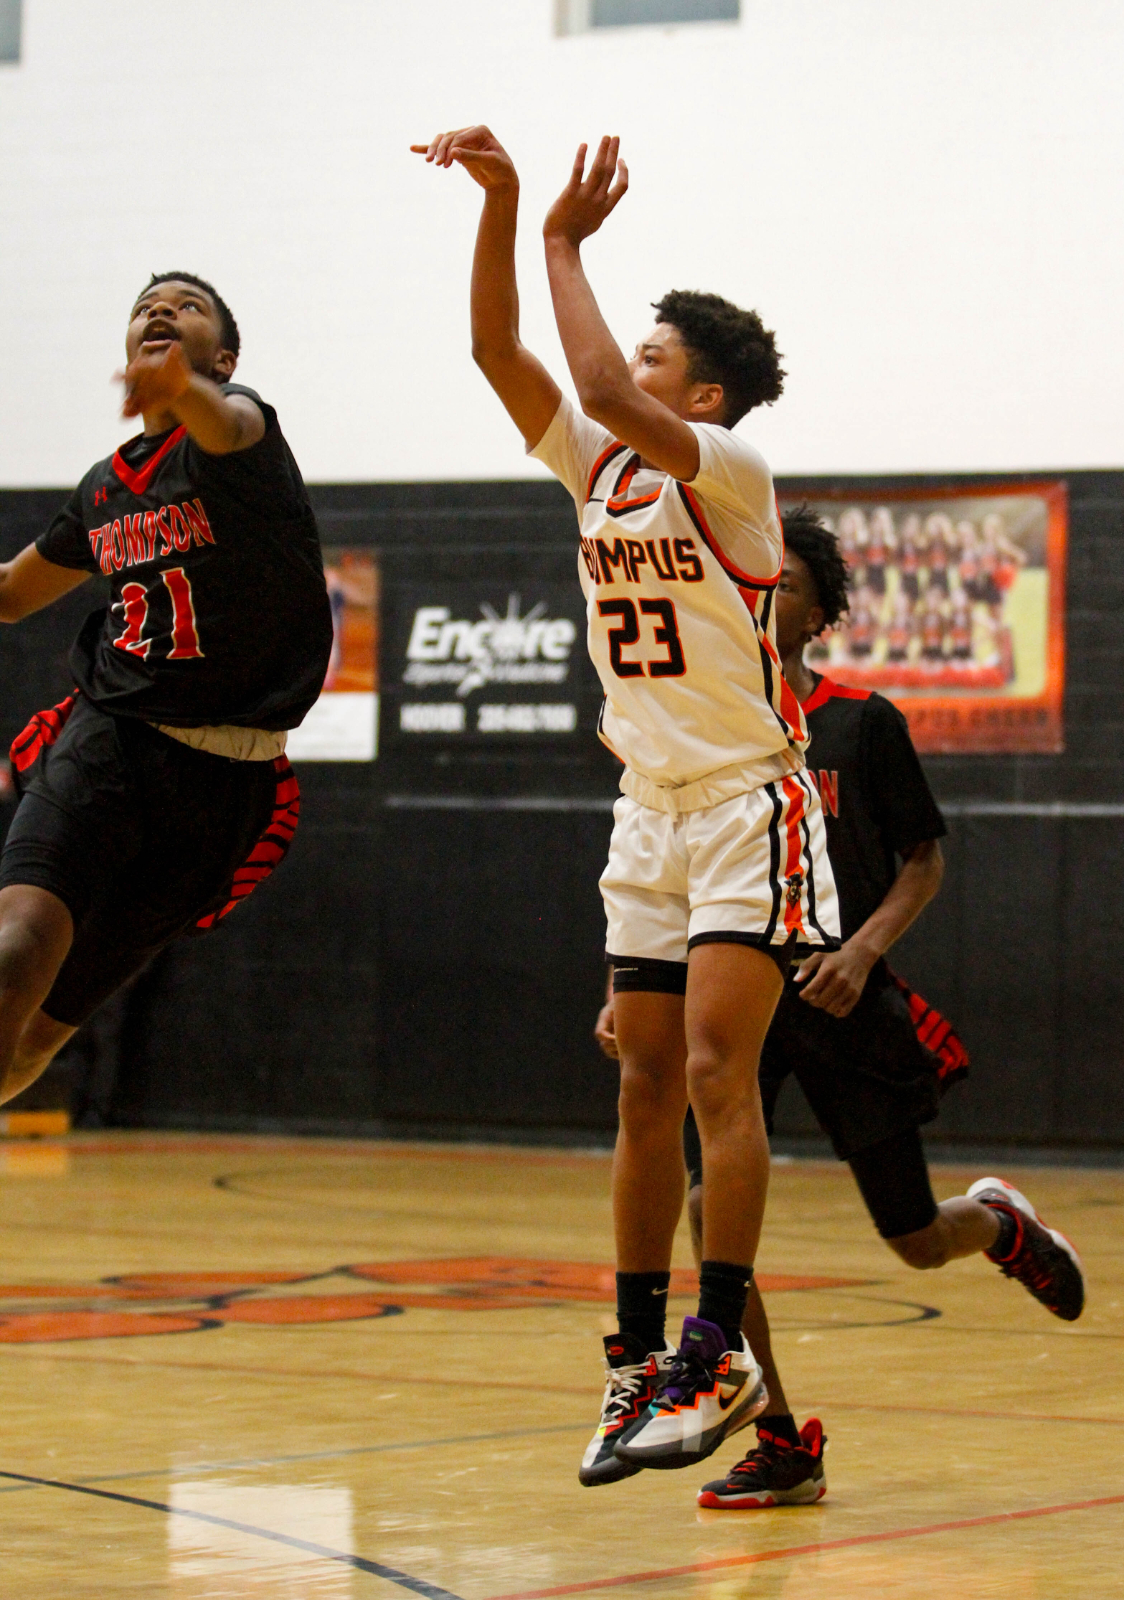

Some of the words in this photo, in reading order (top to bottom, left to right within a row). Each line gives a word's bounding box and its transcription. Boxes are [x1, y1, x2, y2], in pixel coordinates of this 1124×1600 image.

[89, 498, 216, 576] THOMPSON
[580, 535, 705, 585] BUMPUS
[112, 567, 205, 661] 21
[406, 604, 577, 664] Encore
[597, 597, 687, 679] 23
